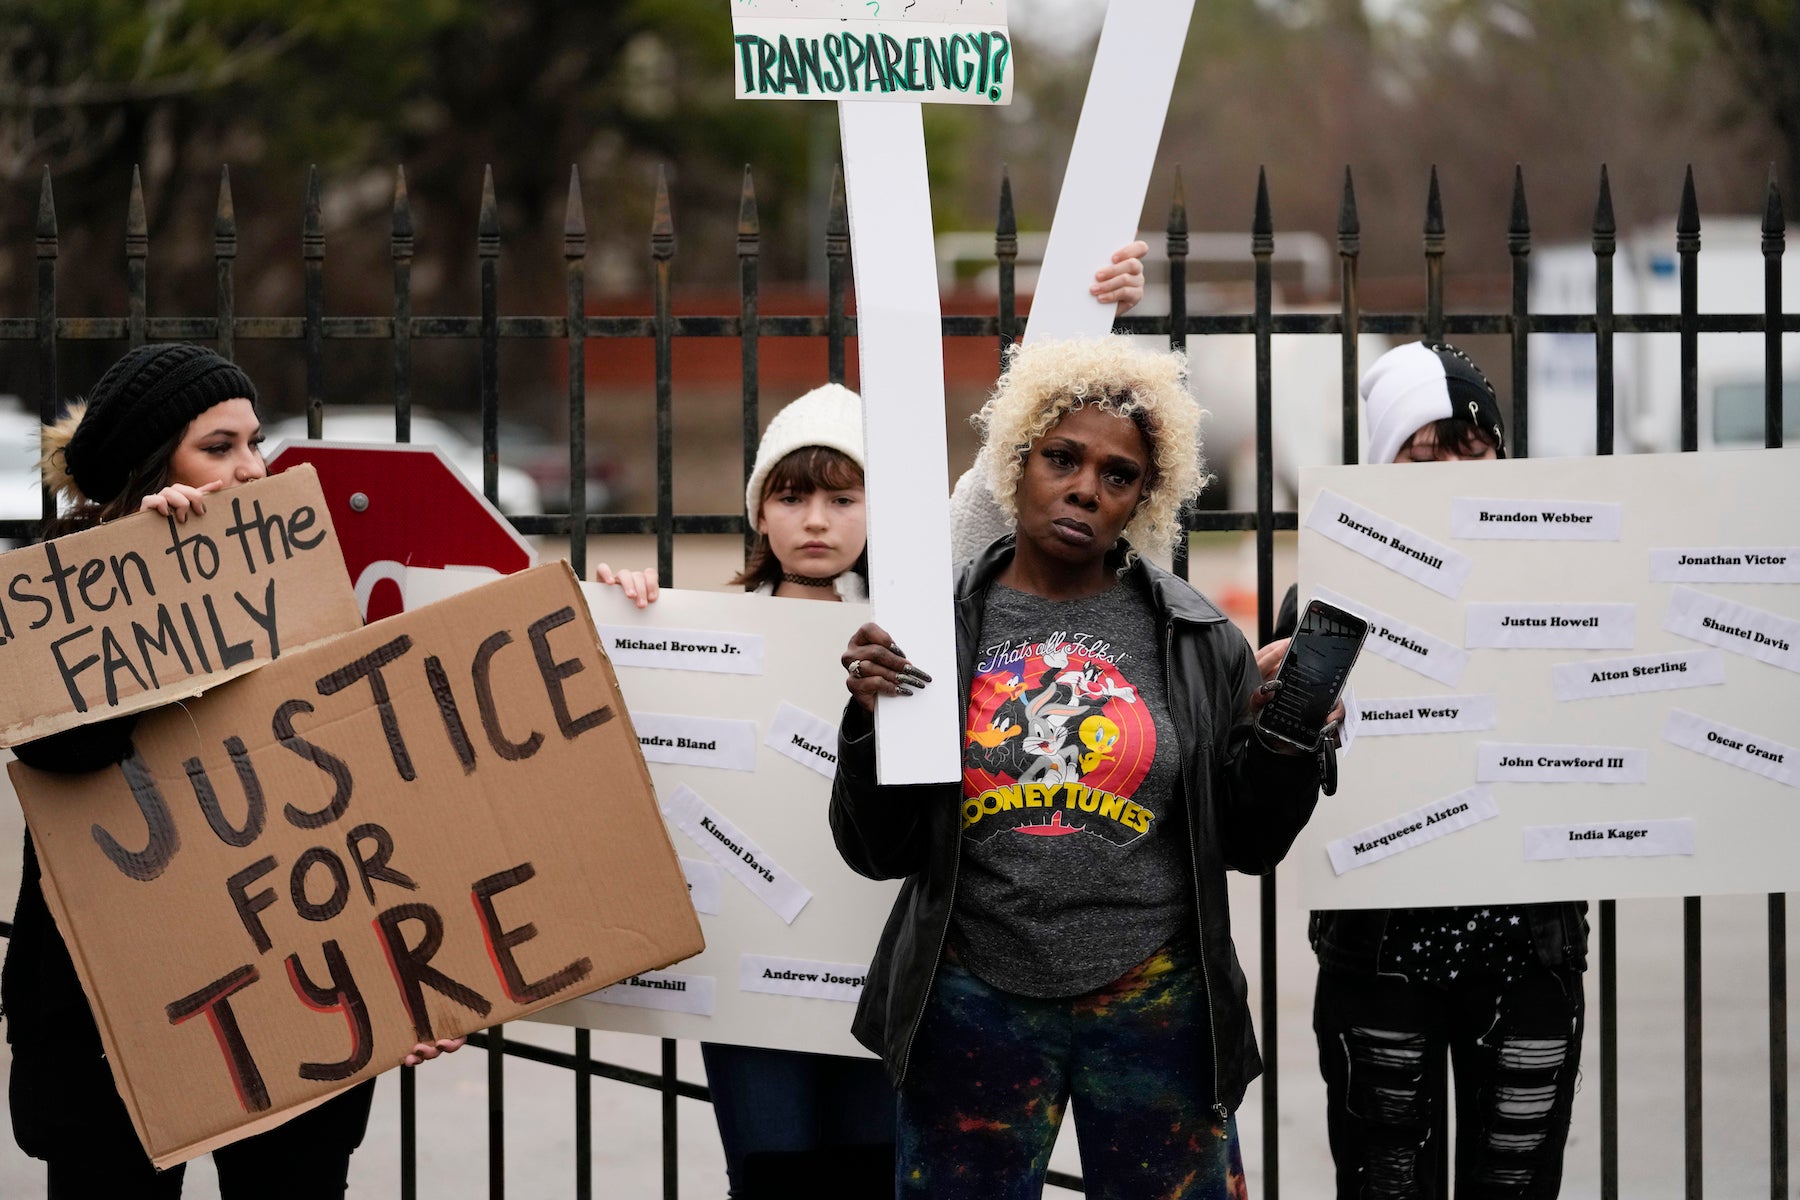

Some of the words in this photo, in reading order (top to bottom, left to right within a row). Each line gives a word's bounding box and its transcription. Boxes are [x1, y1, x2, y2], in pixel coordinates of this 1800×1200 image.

[735, 31, 1010, 102] TRANSPARENCY?
[1479, 511, 1538, 523] Brandon
[1541, 512, 1593, 524] Webber
[1337, 512, 1388, 544] Darrion
[1389, 537, 1443, 570] Barnhill
[0, 542, 156, 646] isten
[166, 514, 220, 584] to
[225, 497, 327, 574] the
[1677, 554, 1742, 566] Jonathan
[1744, 554, 1787, 565] Victor
[1501, 616, 1547, 627] Justus
[1550, 616, 1599, 628] Howell
[1702, 616, 1753, 640] Shantel
[1753, 631, 1790, 651] Davis
[51, 577, 280, 713] FAMILY
[615, 638, 667, 651] Michael
[670, 641, 718, 654] Brown
[720, 643, 741, 656] Jr.
[1036, 631, 1067, 657] all
[1378, 626, 1429, 656] Perkins
[1590, 669, 1630, 683] Alton
[1632, 661, 1688, 678] Sterling
[1361, 709, 1414, 721] Michael
[1417, 707, 1459, 719] Westy
[91, 605, 617, 882] JUSTICE
[676, 737, 717, 751] Bland
[791, 733, 837, 764] Marlon
[1707, 731, 1744, 751] Oscar
[1745, 743, 1785, 764] Grant
[1499, 756, 1534, 767] John
[1537, 756, 1604, 768] Crawford
[1607, 757, 1624, 769] III
[961, 782, 1065, 831] OONEY
[1063, 781, 1156, 834] TUNES
[1352, 822, 1423, 857] Marqueese
[1425, 803, 1470, 827] Alston
[1568, 830, 1605, 842] India
[1607, 828, 1649, 841] Kager
[699, 816, 744, 857] Kimoni
[741, 850, 776, 884] Davis
[225, 822, 419, 955] FOR
[629, 975, 687, 992] Barnhill
[762, 967, 819, 983] Andrew
